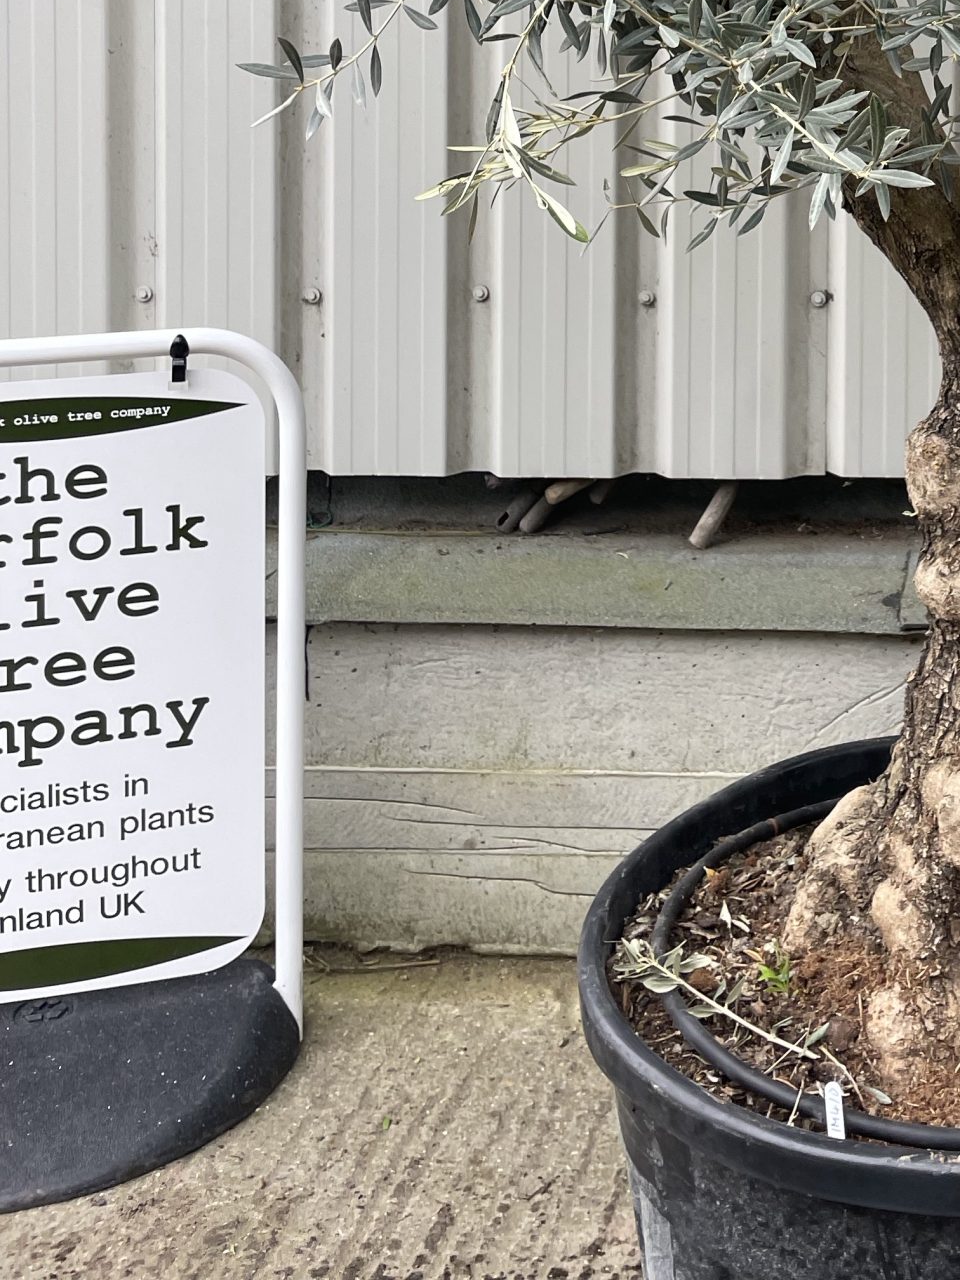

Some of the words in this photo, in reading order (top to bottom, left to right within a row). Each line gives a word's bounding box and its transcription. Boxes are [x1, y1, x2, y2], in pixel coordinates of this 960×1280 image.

[13, 414, 59, 426] olive
[67, 411, 102, 422] tree
[110, 405, 171, 419] company
[0, 456, 108, 506] he
[0, 504, 209, 569] folk
[0, 579, 160, 631] ive
[0, 646, 136, 693] ree
[0, 780, 110, 814] cialists
[124, 773, 149, 798] in
[120, 803, 215, 841] plants
[25, 847, 201, 893] throughout
[0, 899, 84, 933] nland
[99, 890, 146, 919] UK
